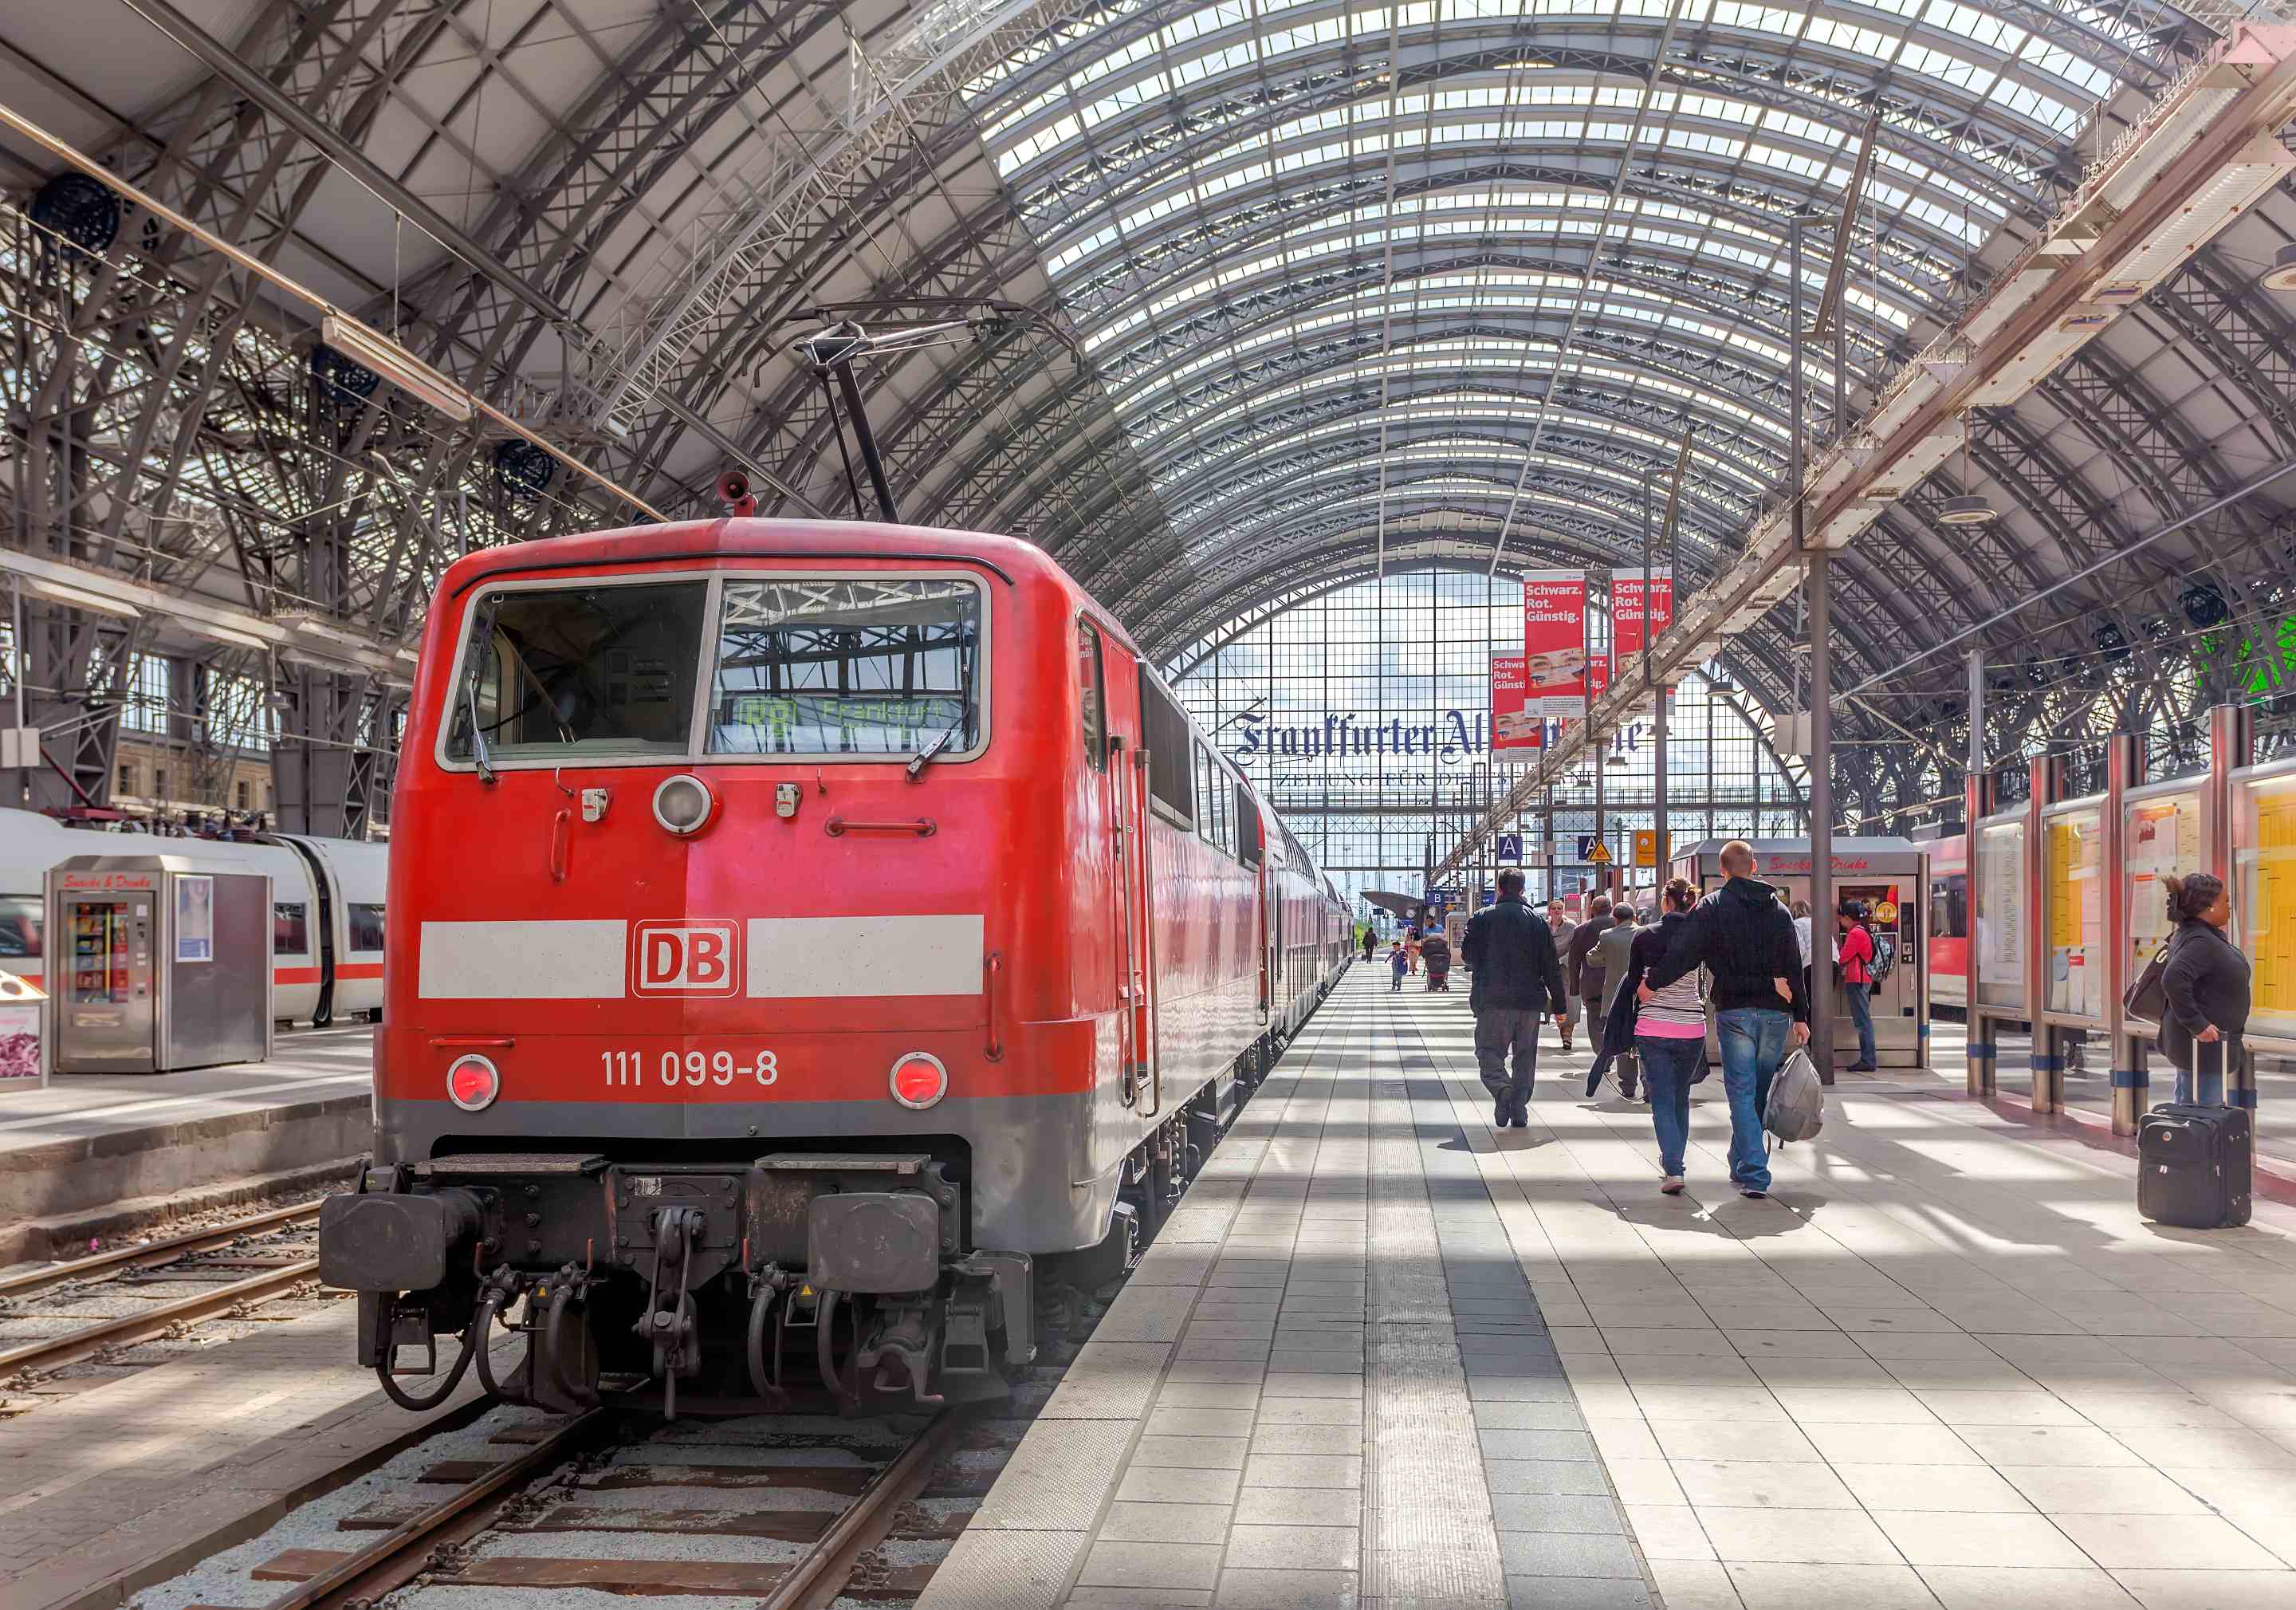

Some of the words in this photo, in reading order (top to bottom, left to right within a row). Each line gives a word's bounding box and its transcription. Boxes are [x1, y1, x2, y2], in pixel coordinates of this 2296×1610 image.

[1526, 585, 1582, 595] Schwarz.
[1526, 599, 1553, 608] Rot.
[1615, 596, 1642, 607] Rot.
[1526, 611, 1580, 624] Günstig.
[1493, 660, 1525, 669] Schwa
[1493, 671, 1515, 679] Rot.
[1494, 680, 1525, 690] Günsti
[1234, 713, 1435, 766] Frankfurter
[1277, 773, 1374, 787] ZEITUNG
[1385, 770, 1427, 786] FÜR
[1502, 837, 1516, 855] A
[1585, 836, 1596, 854] A
[1434, 893, 1441, 903] B
[647, 932, 725, 984] DB
[601, 1051, 642, 1085] 111
[661, 1050, 779, 1086] 099-8
